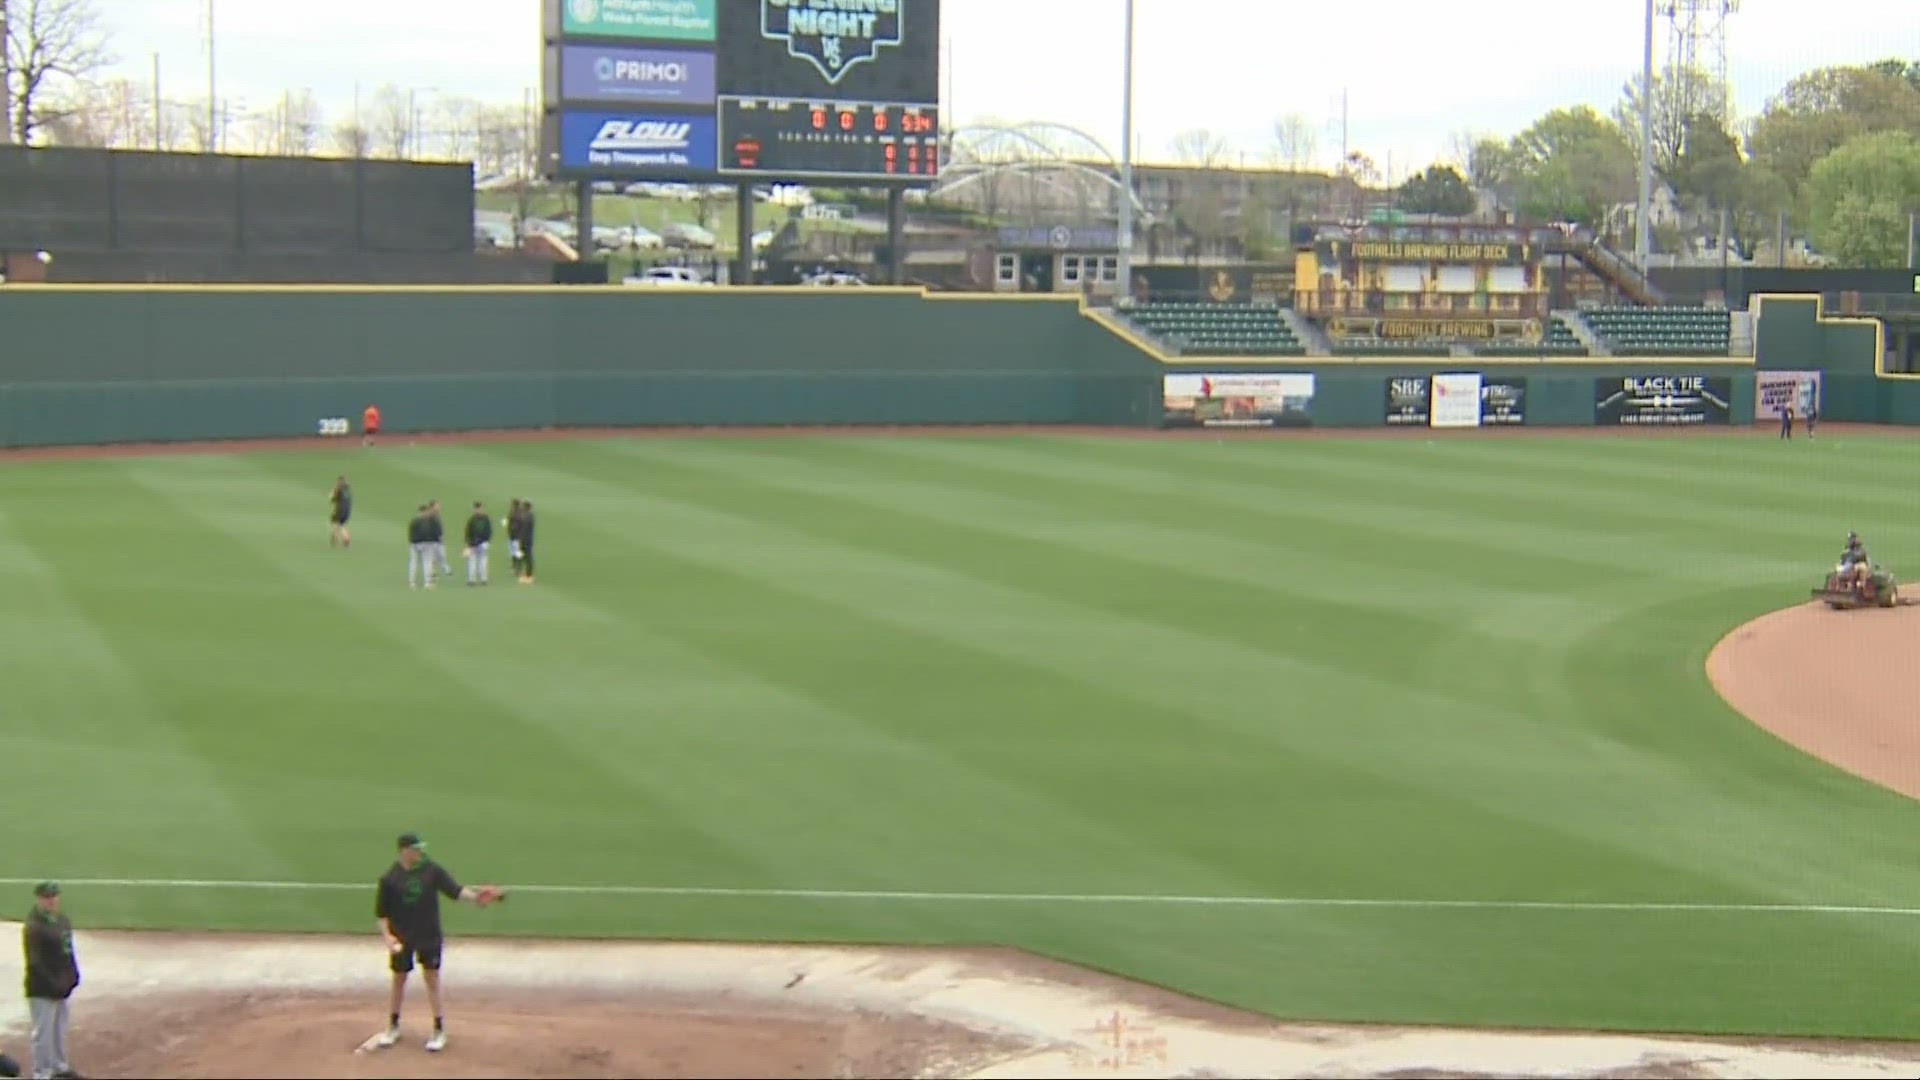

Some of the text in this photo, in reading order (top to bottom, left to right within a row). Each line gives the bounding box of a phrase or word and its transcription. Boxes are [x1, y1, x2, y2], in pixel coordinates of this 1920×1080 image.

[788, 8, 877, 39] NIGHT
[615, 60, 681, 82] PRIMO
[594, 120, 691, 141] FLOW
[1351, 242, 1508, 259] FOOTHILLS BREWING FLIGHT DECK
[1623, 377, 1705, 391] BLACK TIE
